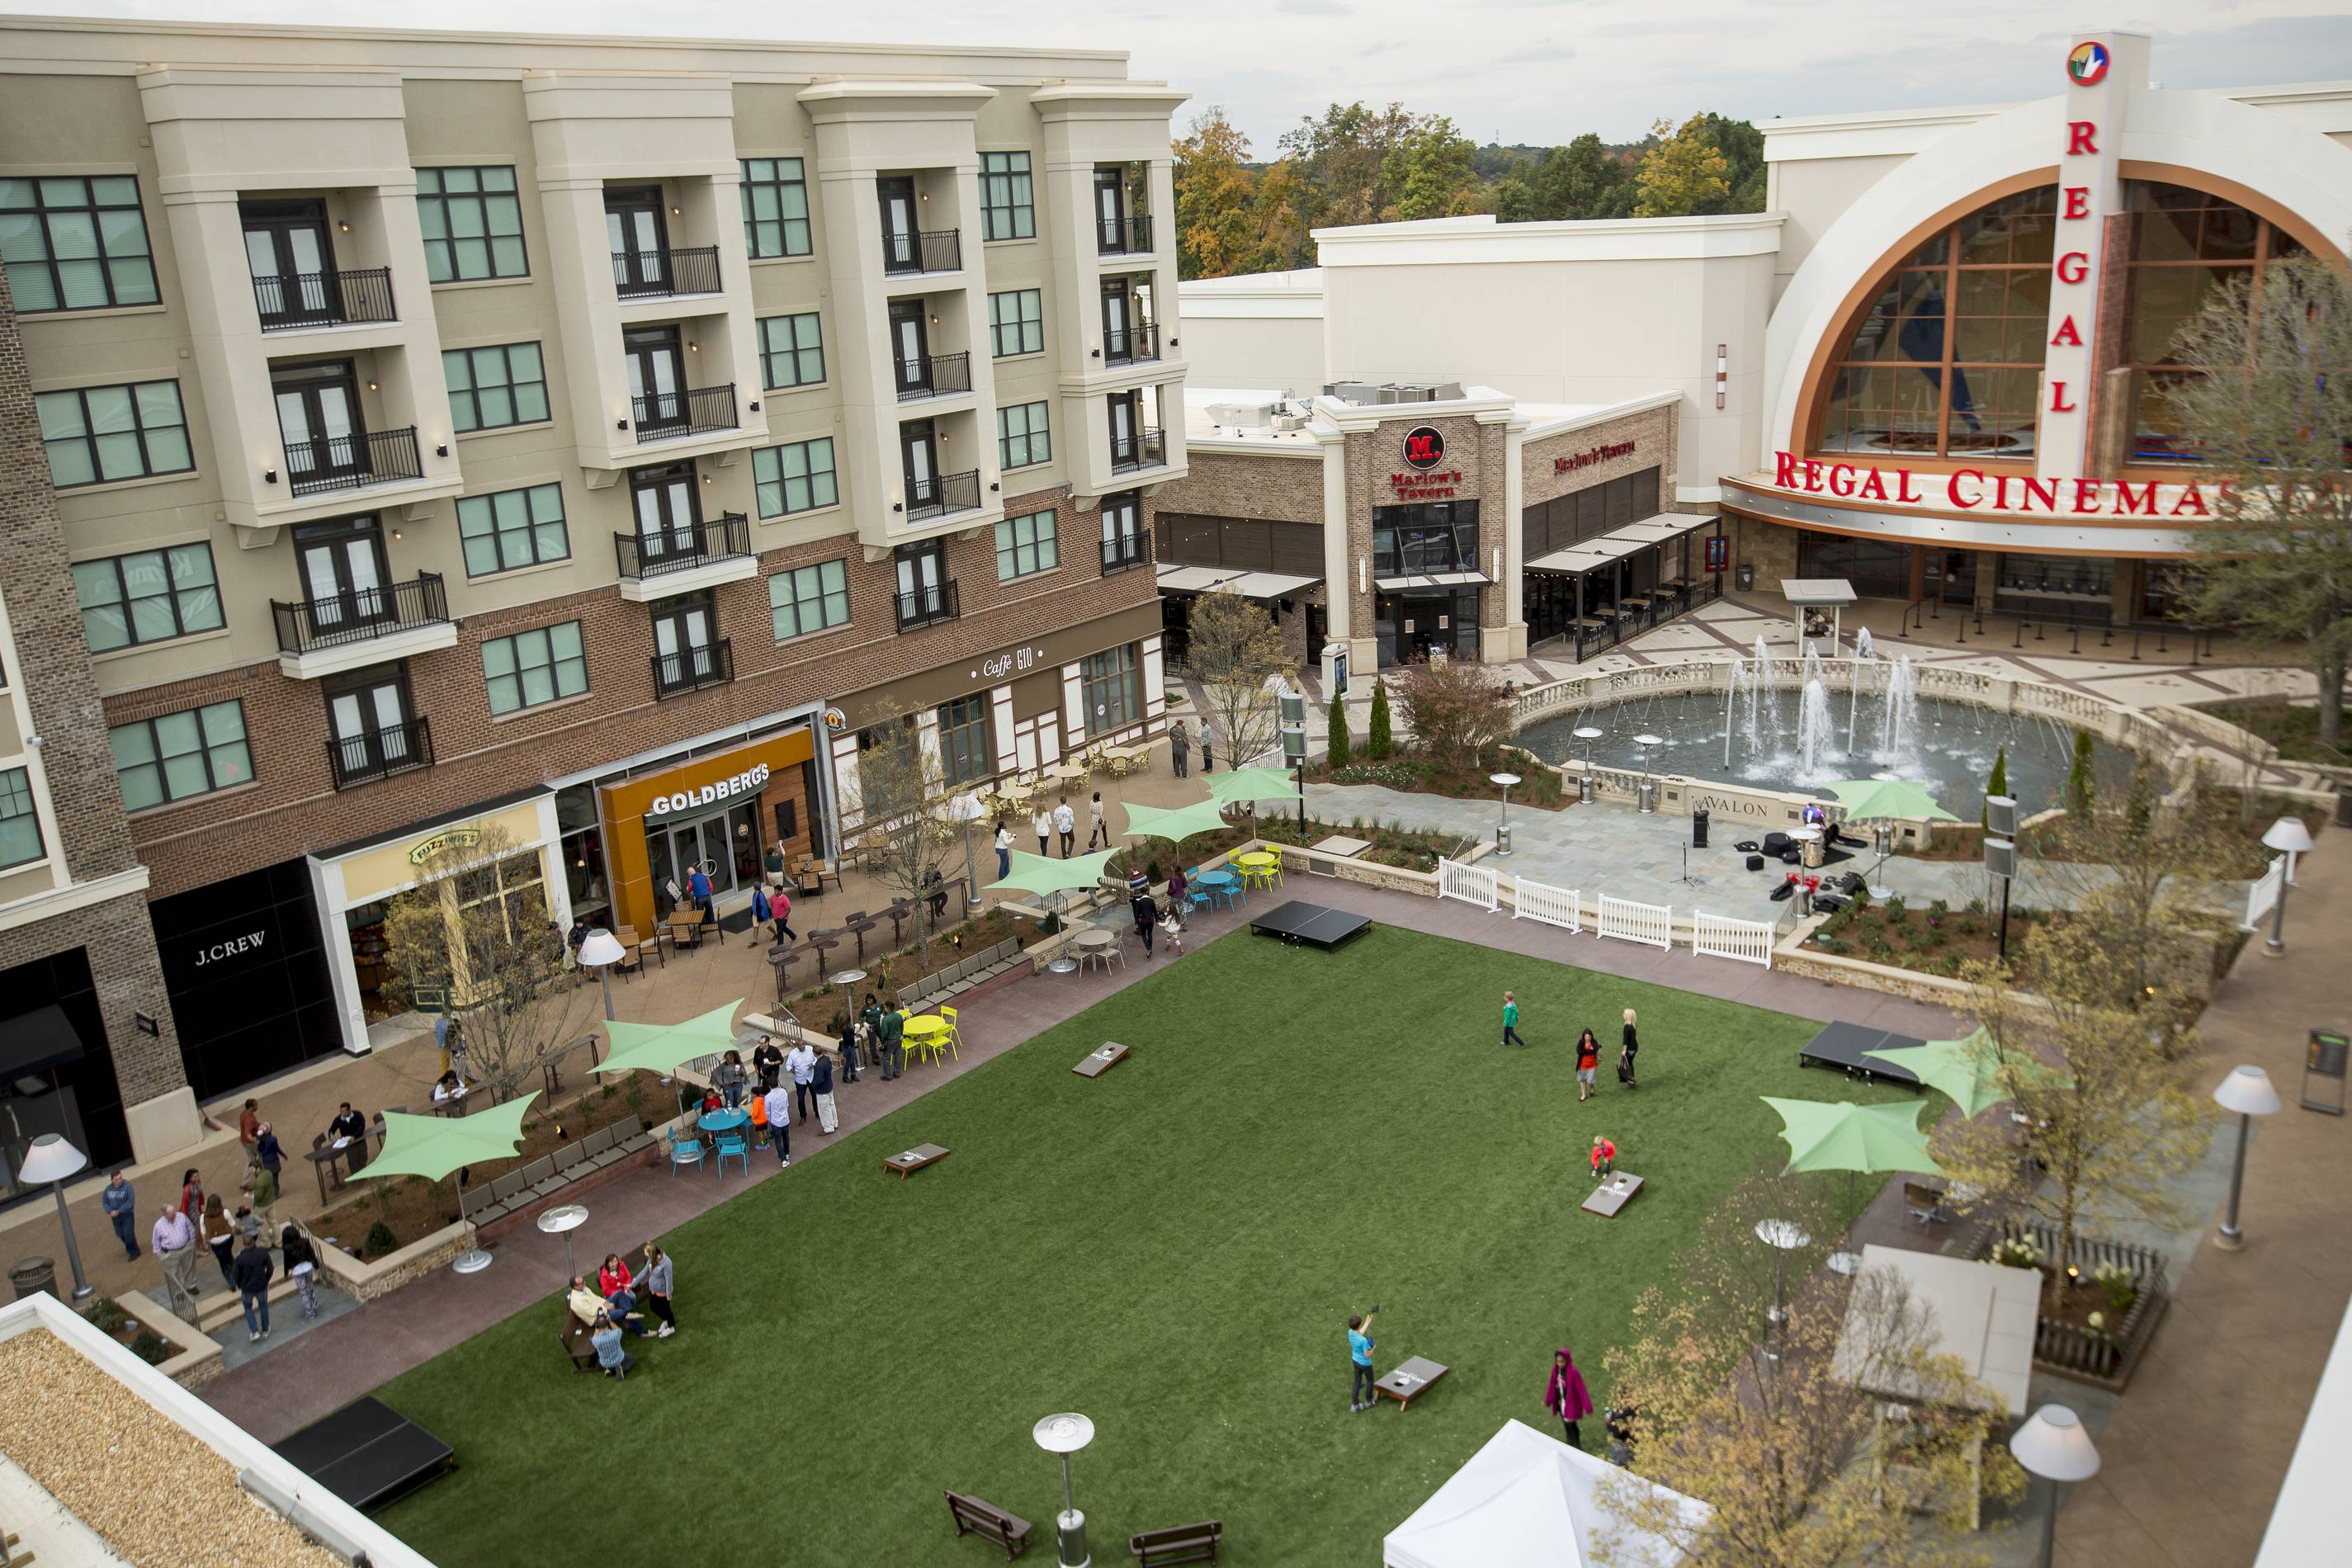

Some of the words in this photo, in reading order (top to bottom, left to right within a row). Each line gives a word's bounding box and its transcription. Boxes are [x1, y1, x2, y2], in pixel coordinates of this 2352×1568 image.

[2050, 120, 2099, 413] REGAL
[1554, 447, 1600, 476] Marlow's
[1600, 440, 1636, 461] Tavern
[1391, 470, 1462, 487] Marlow's
[1774, 451, 1923, 503] REGAL
[1397, 487, 1455, 501] Tavern
[1017, 647, 1032, 670] GIO
[1701, 796, 1769, 816] AVALON
[195, 930, 266, 966] J.CREW
